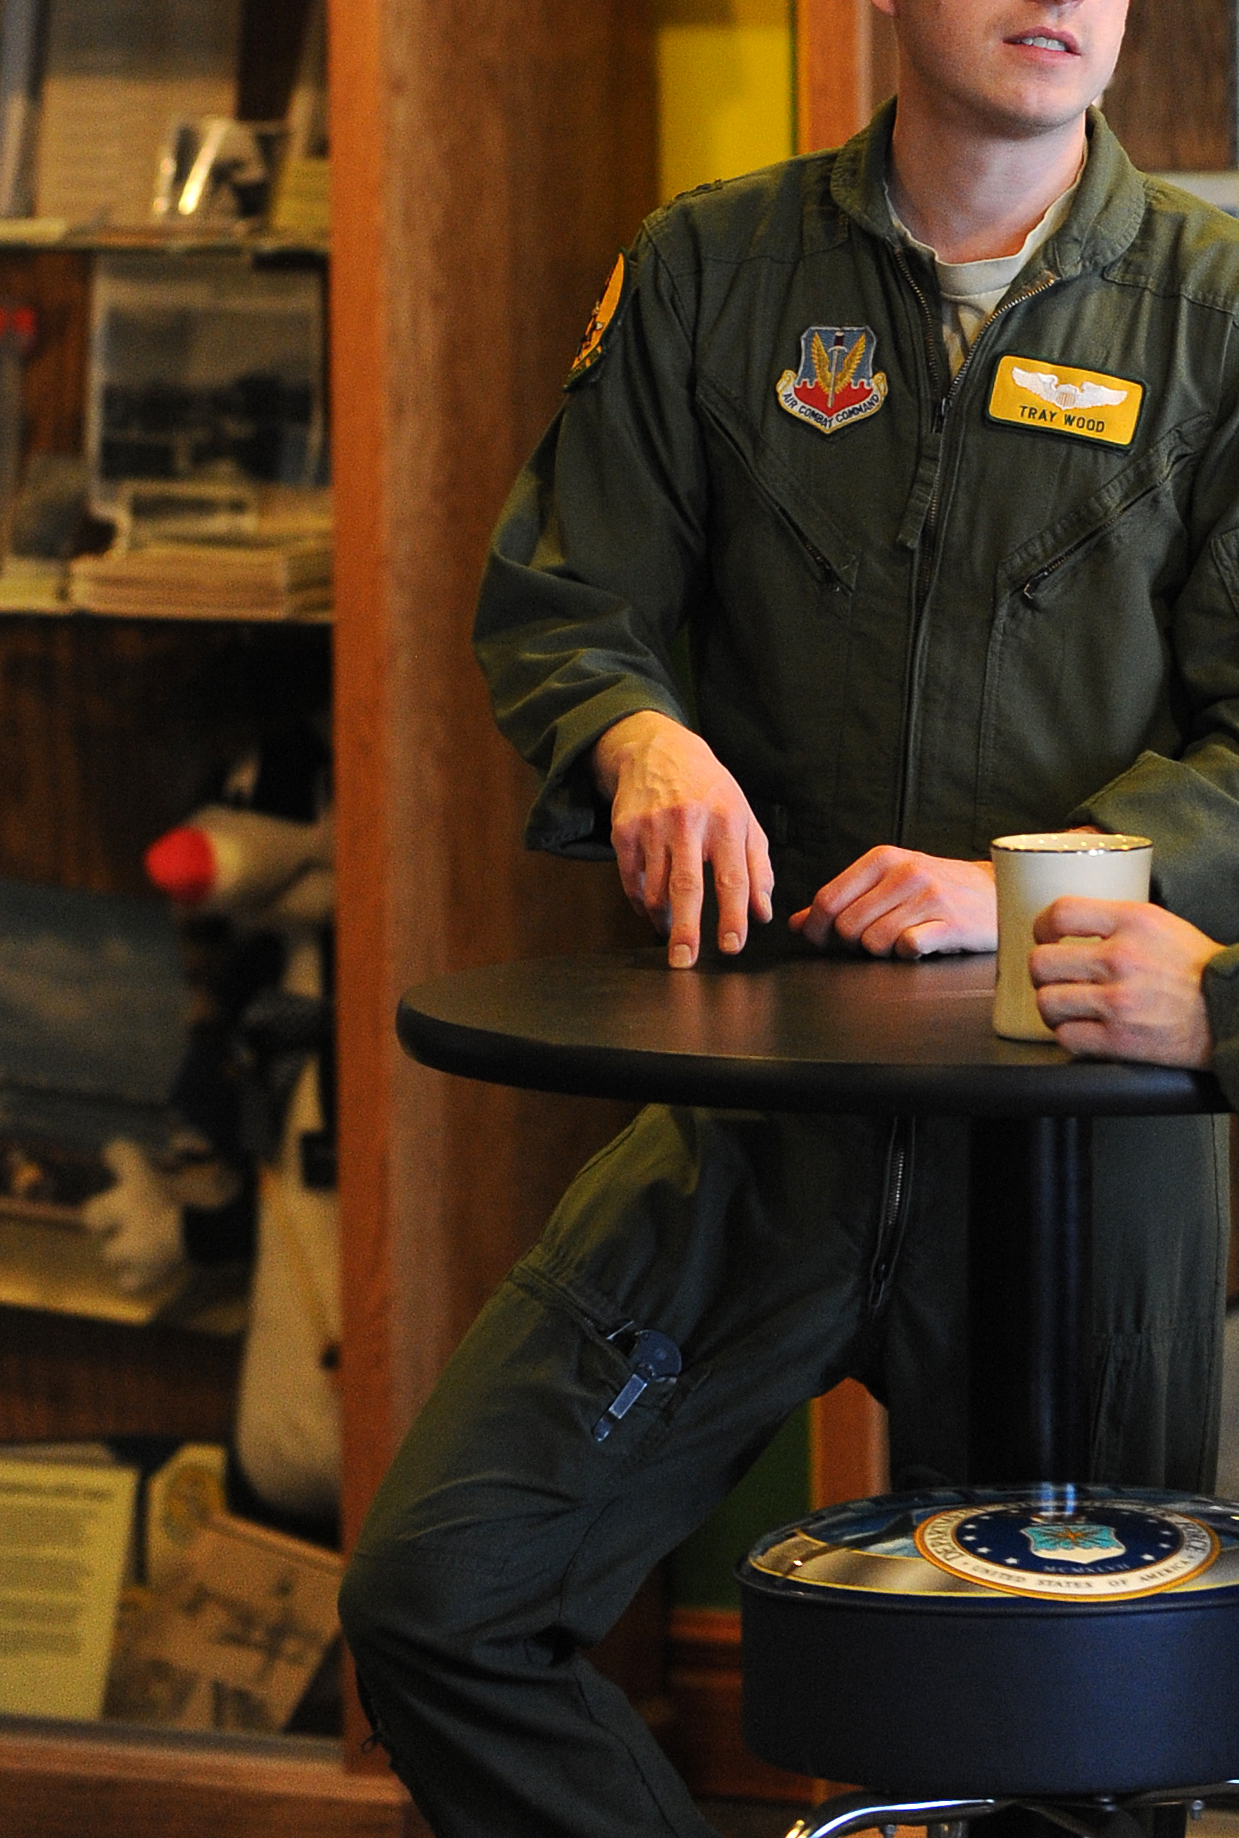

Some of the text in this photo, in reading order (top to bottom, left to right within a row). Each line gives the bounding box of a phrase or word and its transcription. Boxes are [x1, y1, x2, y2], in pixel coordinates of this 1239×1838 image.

[783, 392, 880, 428] AIR COMBAT COMMAND
[1019, 405, 1106, 433] TRAY WOOD
[972, 1561, 1191, 1589] UNITED STATES OF AMERICA
